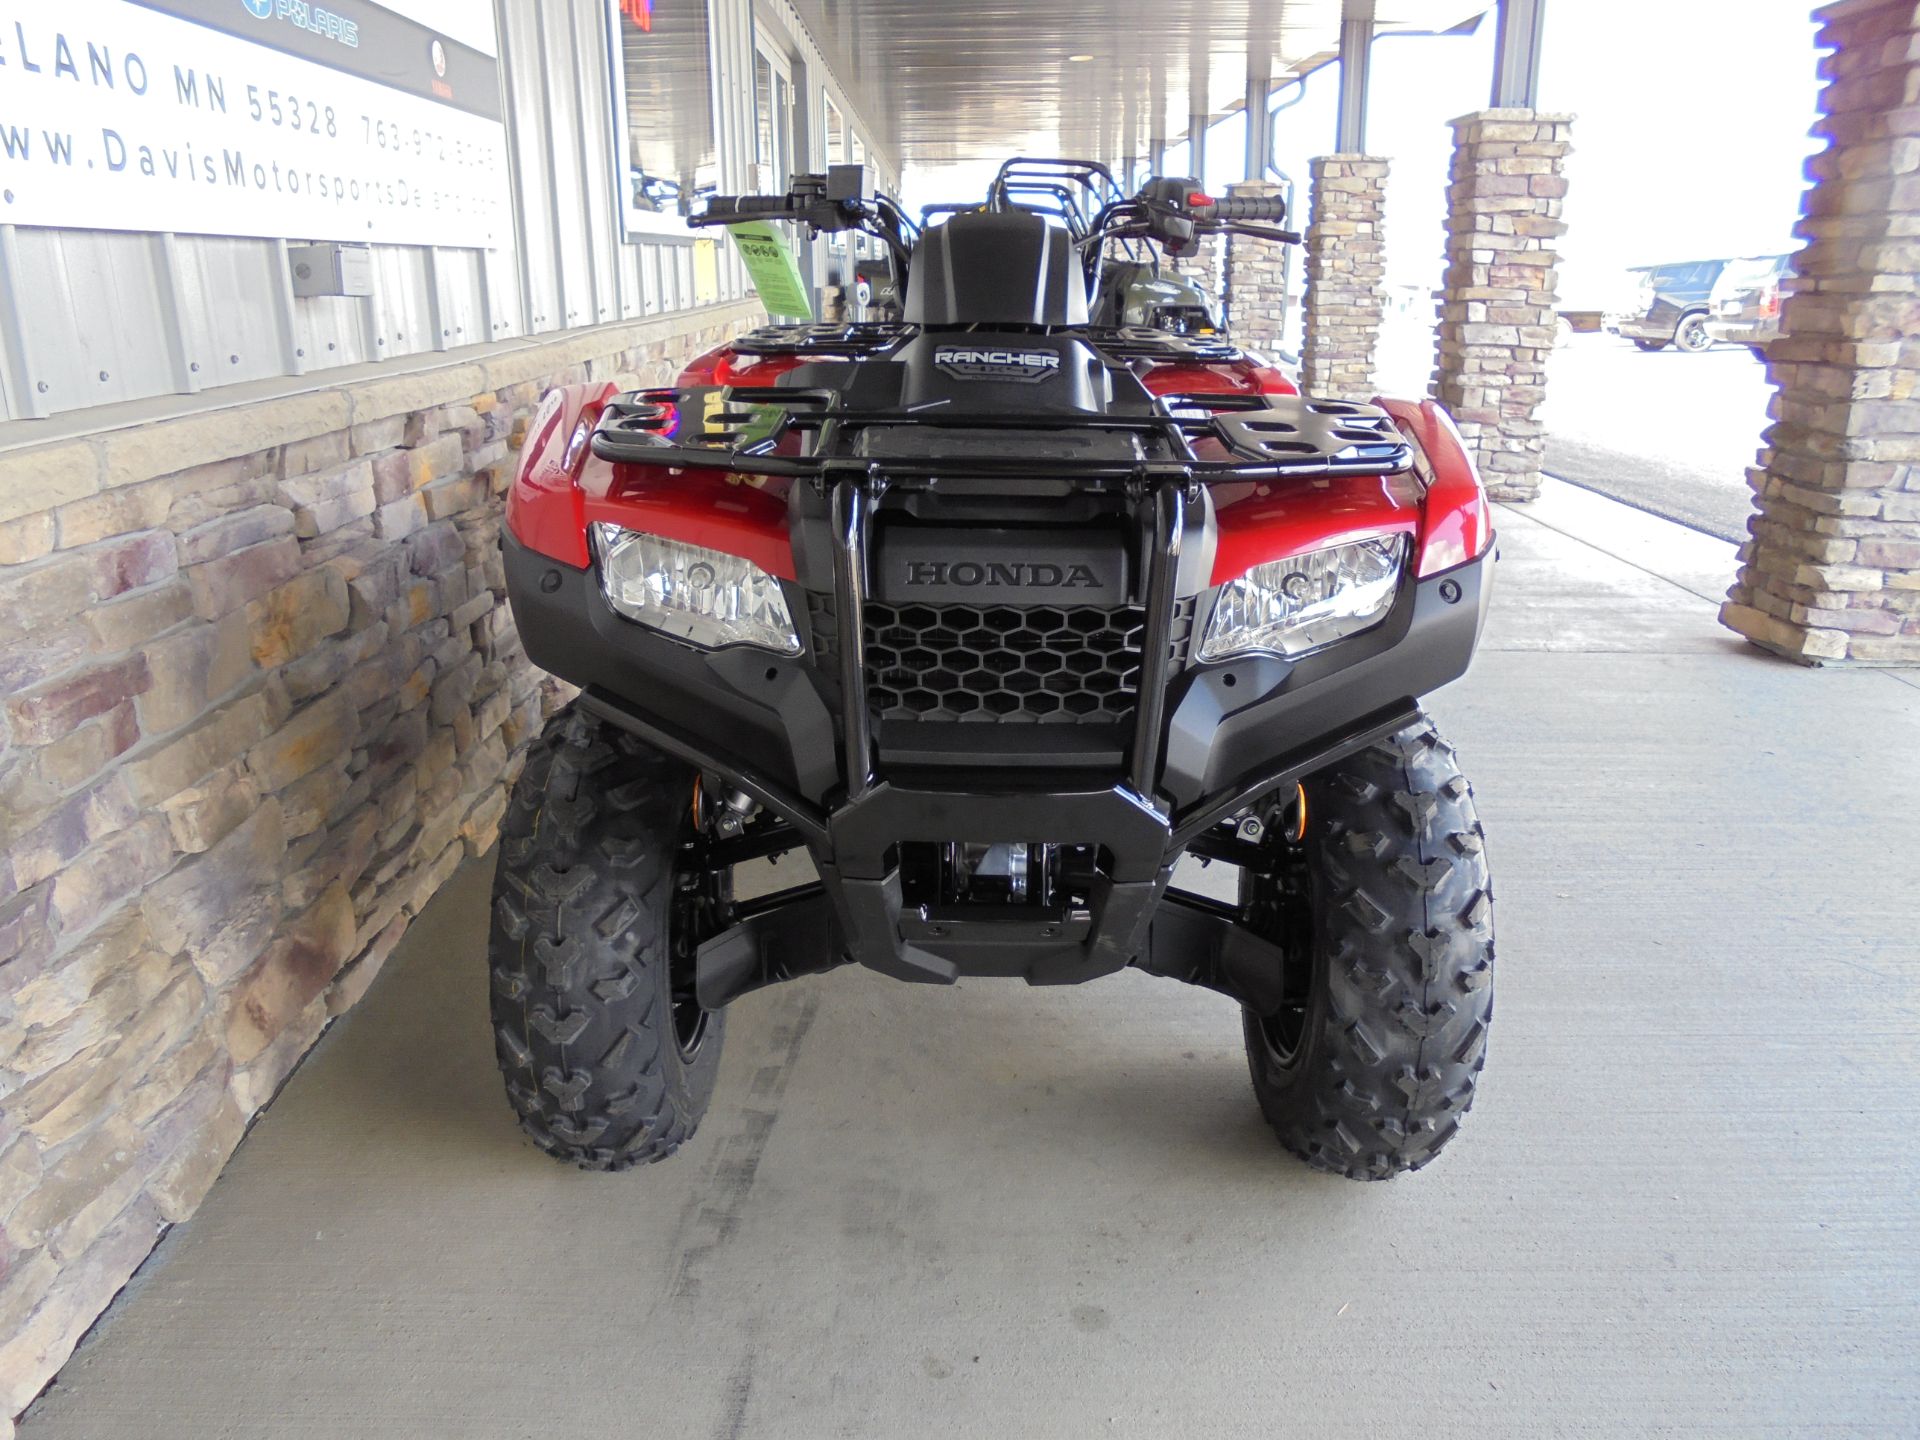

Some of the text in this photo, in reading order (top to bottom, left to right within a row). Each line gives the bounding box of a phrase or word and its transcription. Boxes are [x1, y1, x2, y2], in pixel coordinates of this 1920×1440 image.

[0, 21, 148, 96] LANO
[174, 65, 226, 114] MN
[246, 84, 337, 138] 55328
[934, 351, 1060, 369] RANCHER
[905, 561, 1103, 588] HONDA
